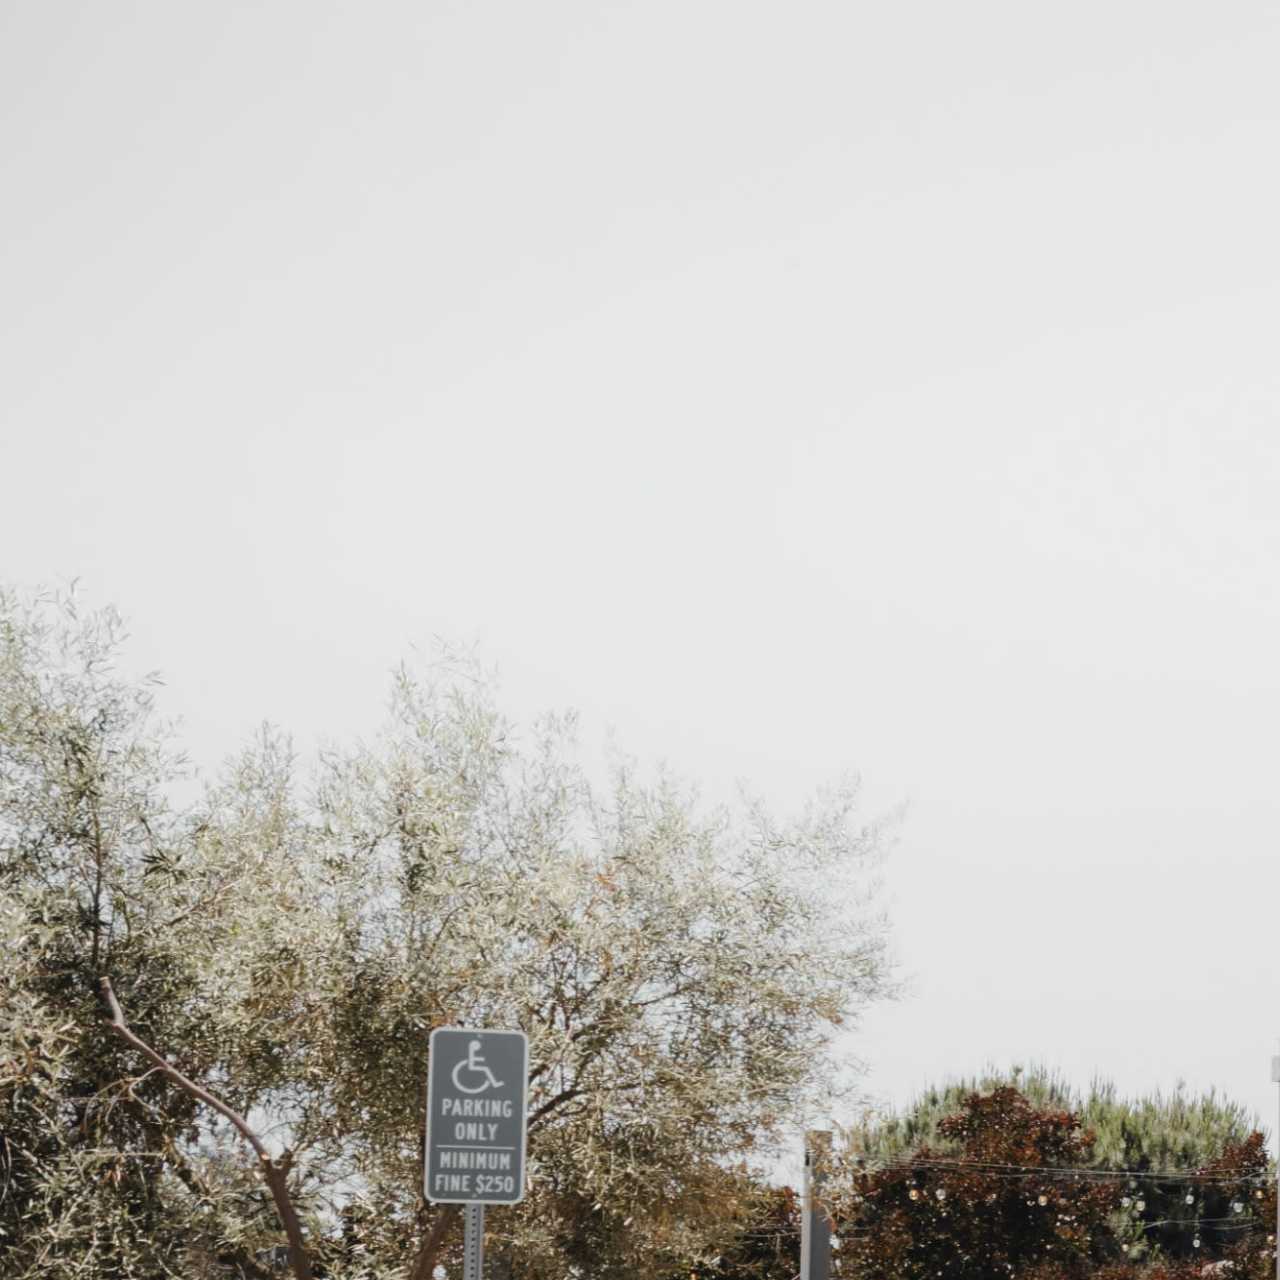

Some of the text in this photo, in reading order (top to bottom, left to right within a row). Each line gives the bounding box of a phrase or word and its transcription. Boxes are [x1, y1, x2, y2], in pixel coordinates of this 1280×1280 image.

[441, 1098, 513, 1118] PARKING
[455, 1122, 499, 1141] ONLY
[440, 1151, 511, 1170] MINIMUM
[435, 1174, 515, 1194] FINE $250
